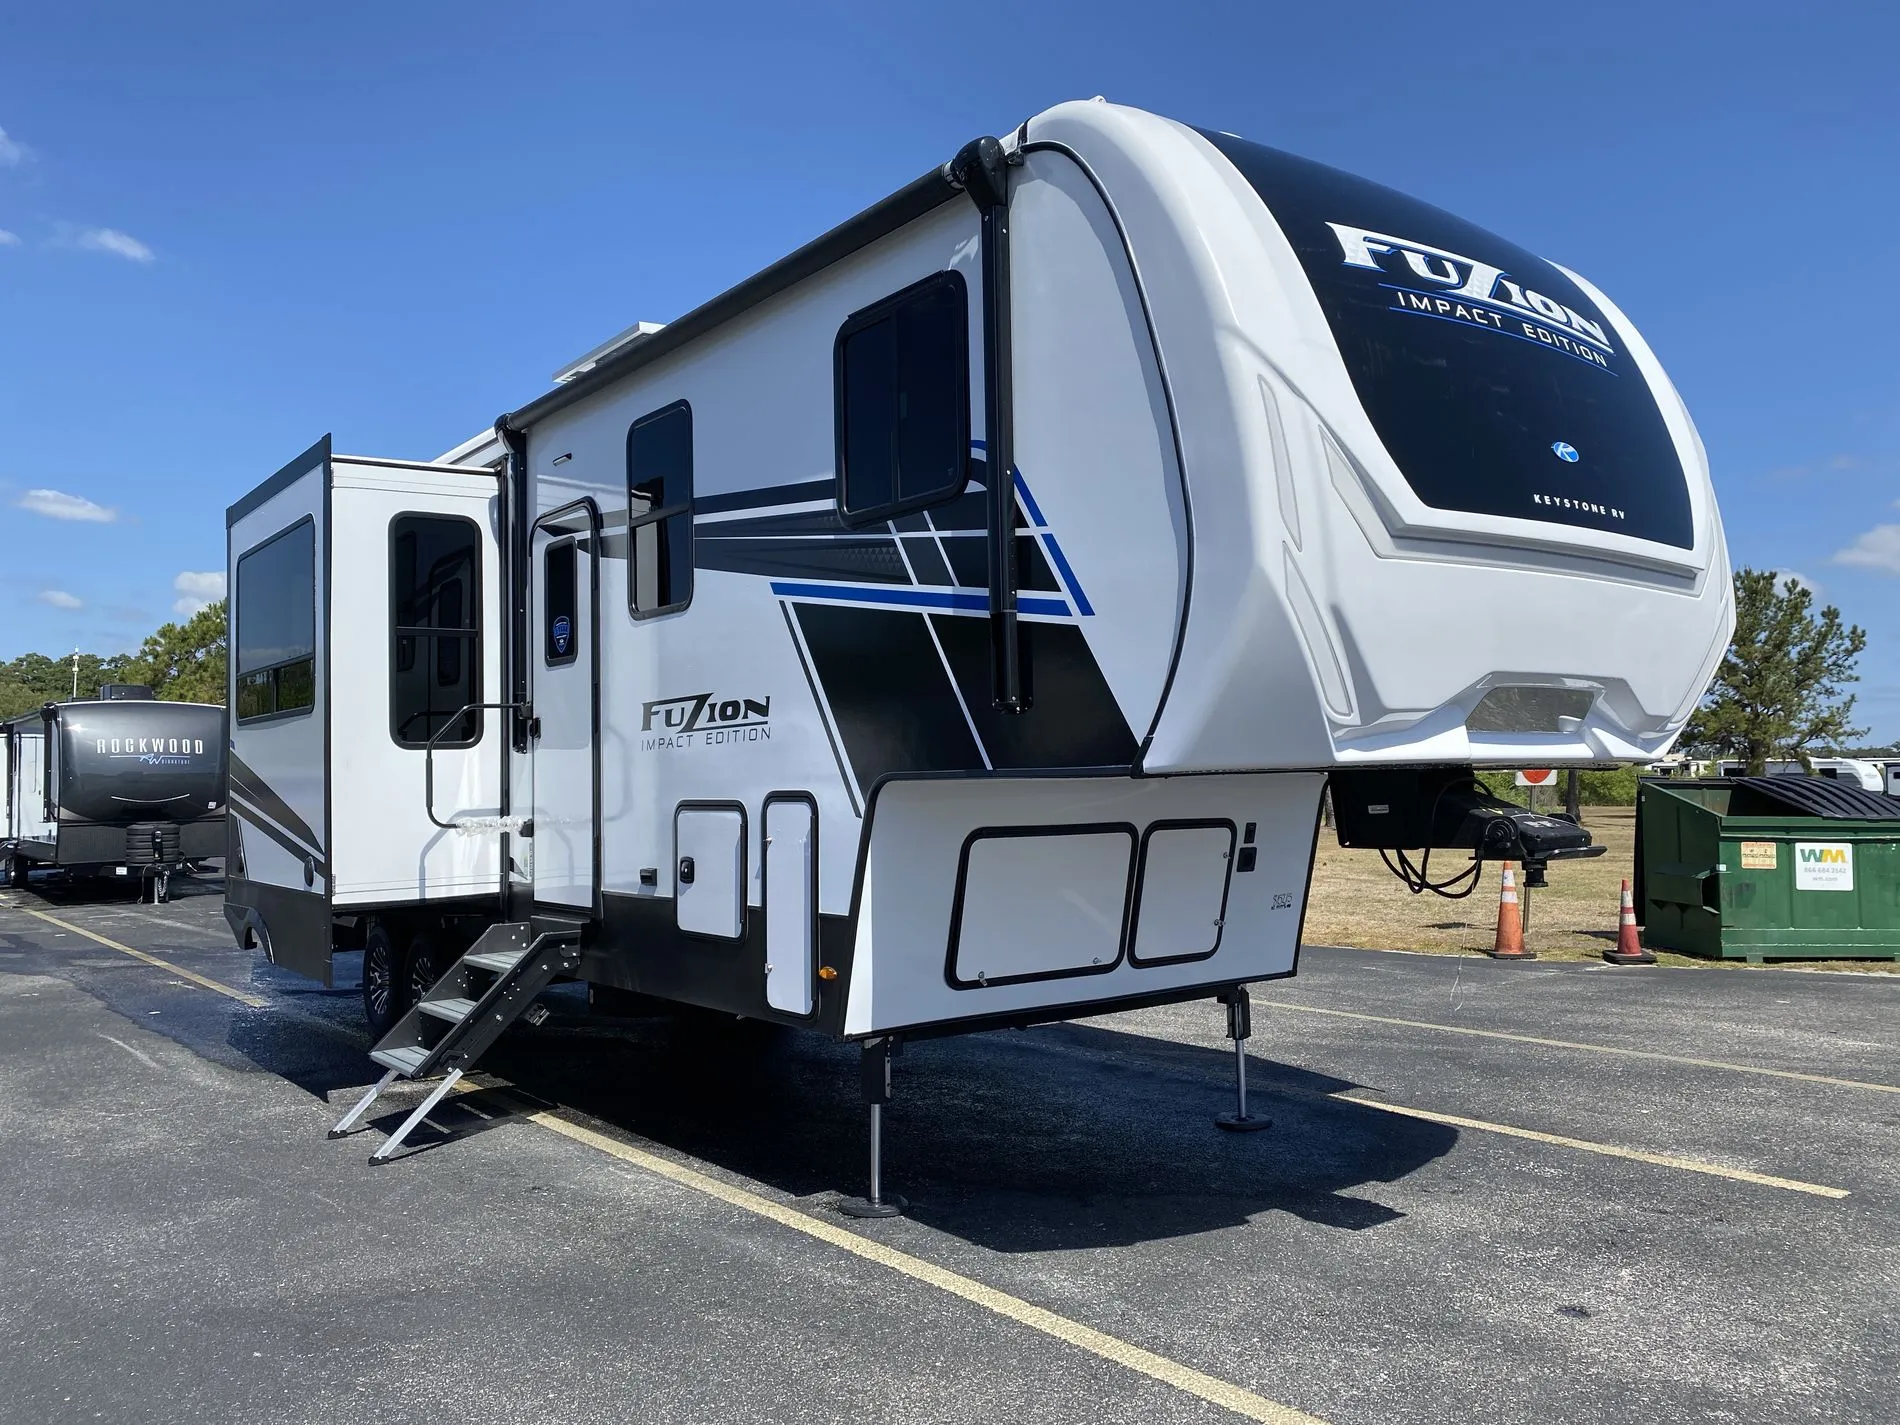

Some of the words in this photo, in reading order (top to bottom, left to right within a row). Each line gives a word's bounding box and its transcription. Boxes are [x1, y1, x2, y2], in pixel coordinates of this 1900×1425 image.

[1398, 291, 1503, 328] IMPACT
[1522, 323, 1607, 368] EDITION
[1534, 494, 1606, 515] KEYSTONE
[1611, 508, 1626, 520] RV
[96, 738, 203, 754] ROCKWOOD
[641, 734, 693, 751] IMPACT
[705, 727, 771, 745] EDITION
[1800, 848, 1847, 863] WM
